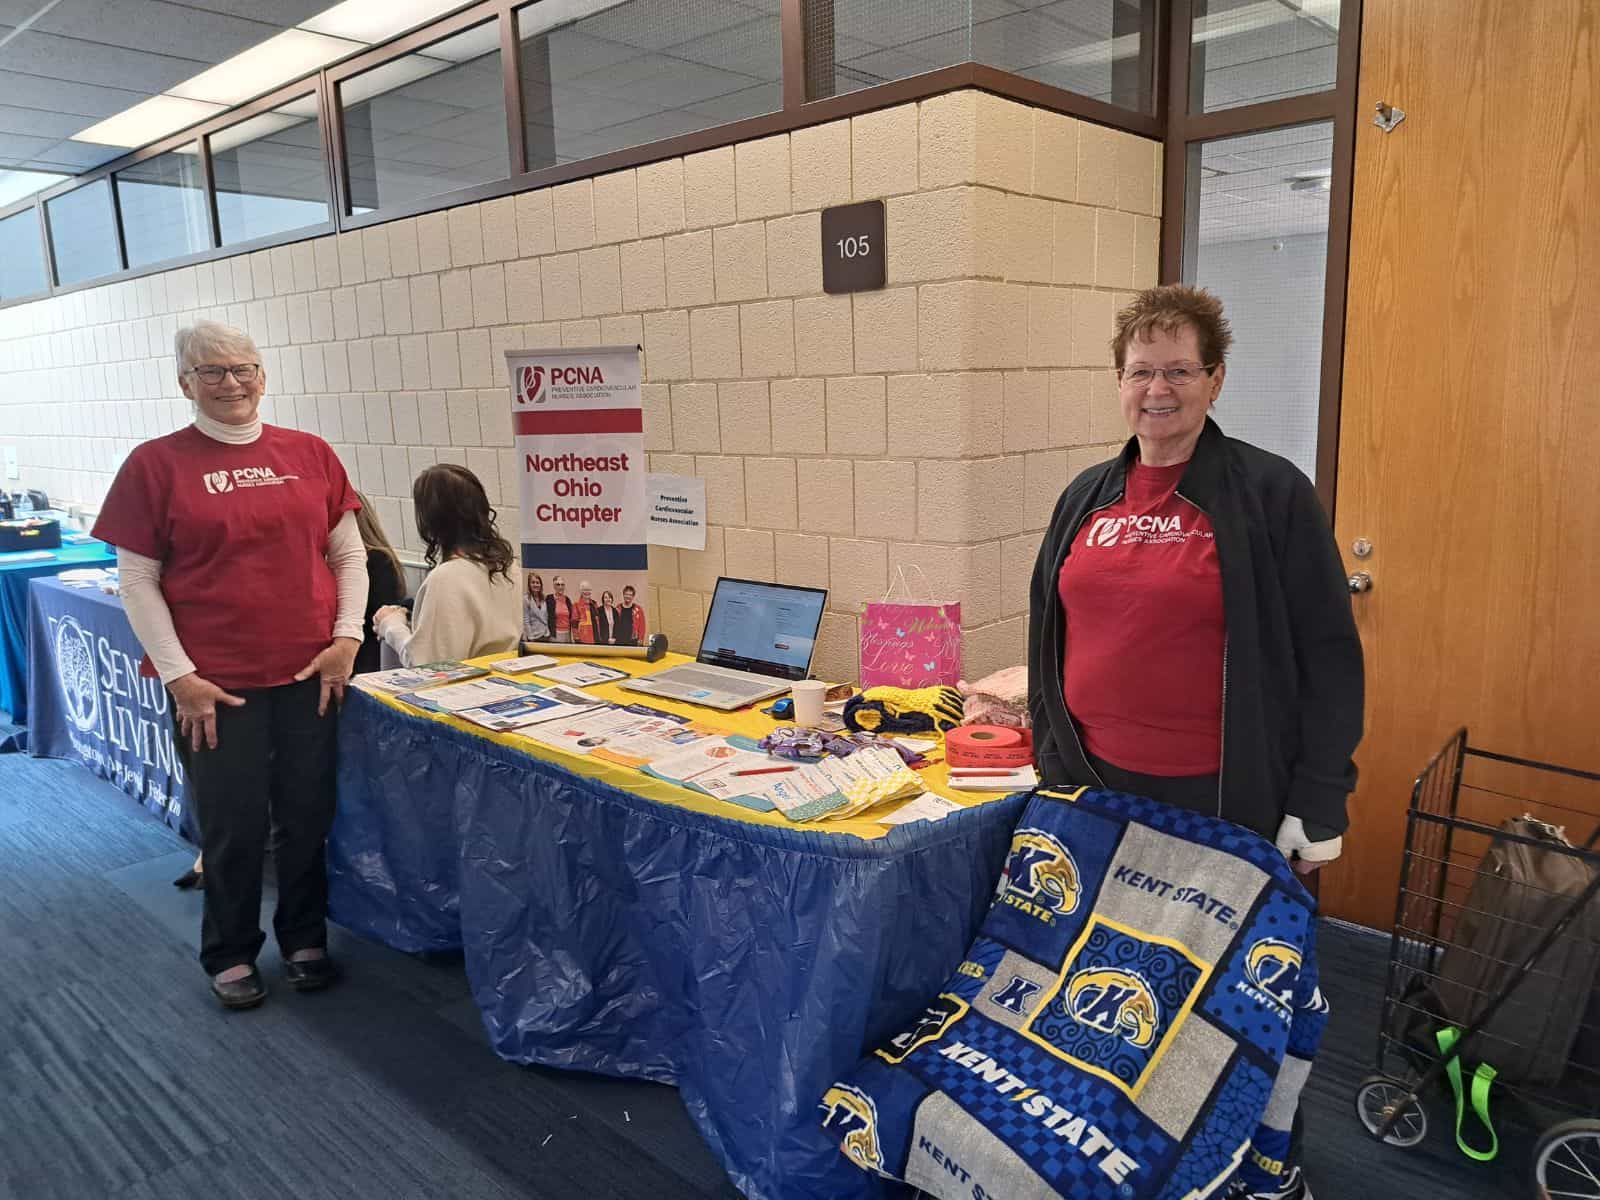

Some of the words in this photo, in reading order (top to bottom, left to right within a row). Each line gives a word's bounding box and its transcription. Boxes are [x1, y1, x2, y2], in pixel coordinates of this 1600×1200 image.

[837, 234, 870, 259] 105
[550, 366, 605, 386] PCNA
[232, 467, 276, 480] PCNA
[526, 453, 629, 472] Northeast
[553, 477, 602, 497] Ohio
[536, 504, 622, 528] Chapter
[1126, 515, 1182, 533] PCNA
[860, 643, 914, 675] Love
[98, 637, 168, 715] SENIO
[102, 691, 184, 785] LIVING
[1114, 865, 1174, 898] KENT
[1173, 886, 1237, 925] STATE
[990, 976, 1041, 1015] K
[938, 1041, 1027, 1095] KENT
[1021, 1094, 1141, 1186] STATE
[918, 1135, 972, 1185] KENT
